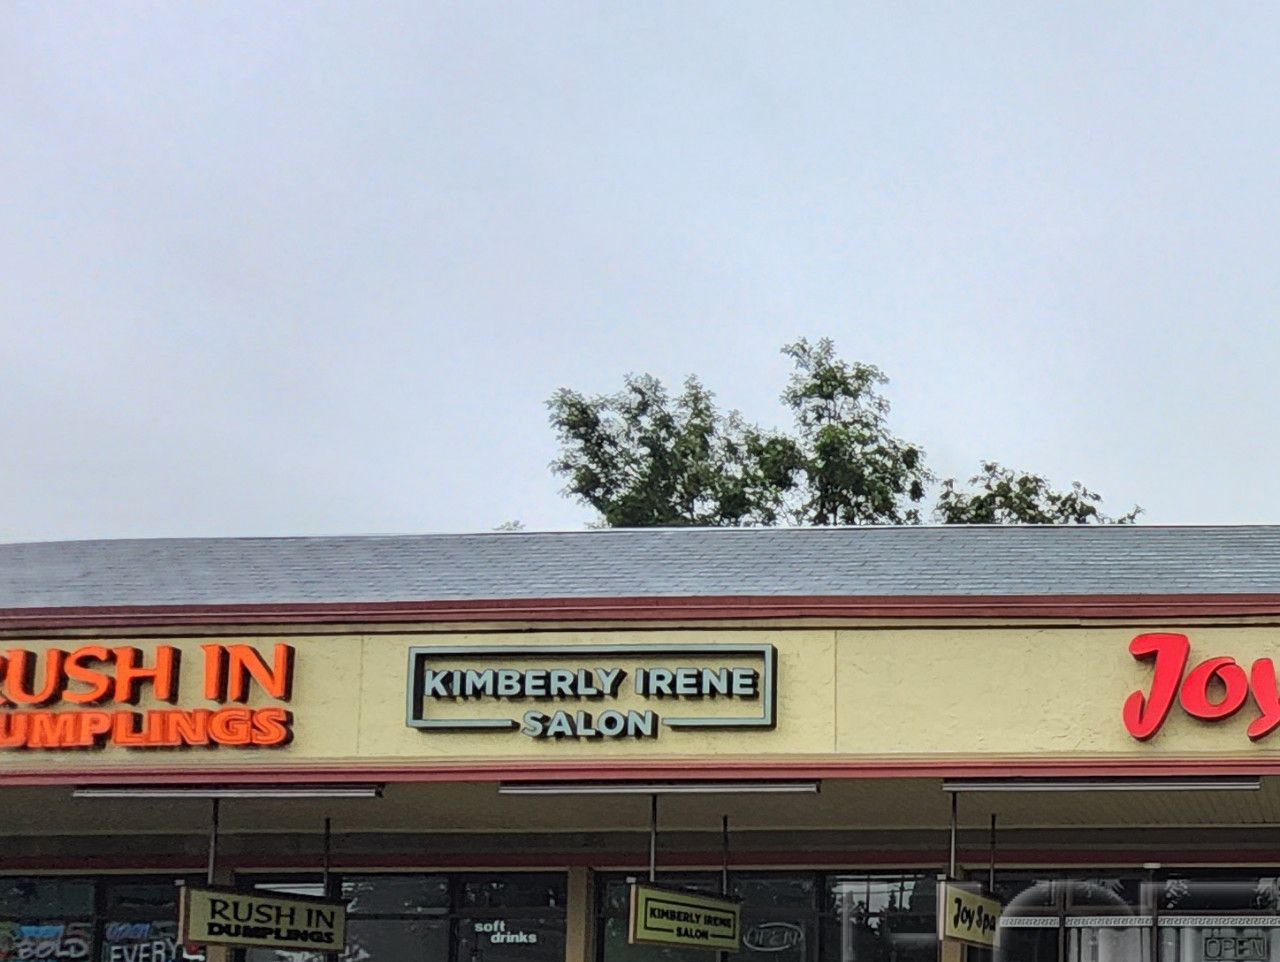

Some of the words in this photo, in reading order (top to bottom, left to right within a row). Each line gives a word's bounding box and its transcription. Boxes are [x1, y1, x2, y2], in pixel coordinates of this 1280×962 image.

[0, 643, 176, 704] USH
[201, 642, 292, 700] IN
[424, 668, 622, 698] KIMBERLY
[635, 667, 757, 697] IRENE
[521, 710, 656, 738] SALON
[208, 898, 296, 926] RUSH
[305, 908, 336, 930] IN
[649, 907, 701, 926] KIMBERLY
[703, 913, 733, 930] IRENE
[953, 896, 976, 932] Joy
[976, 904, 997, 937] Spa
[206, 922, 335, 944] DUMPLINGS
[474, 920, 506, 932] soft
[491, 931, 538, 944] drinks
[675, 927, 709, 941] SALON
[1206, 938, 1265, 959] OPEN
